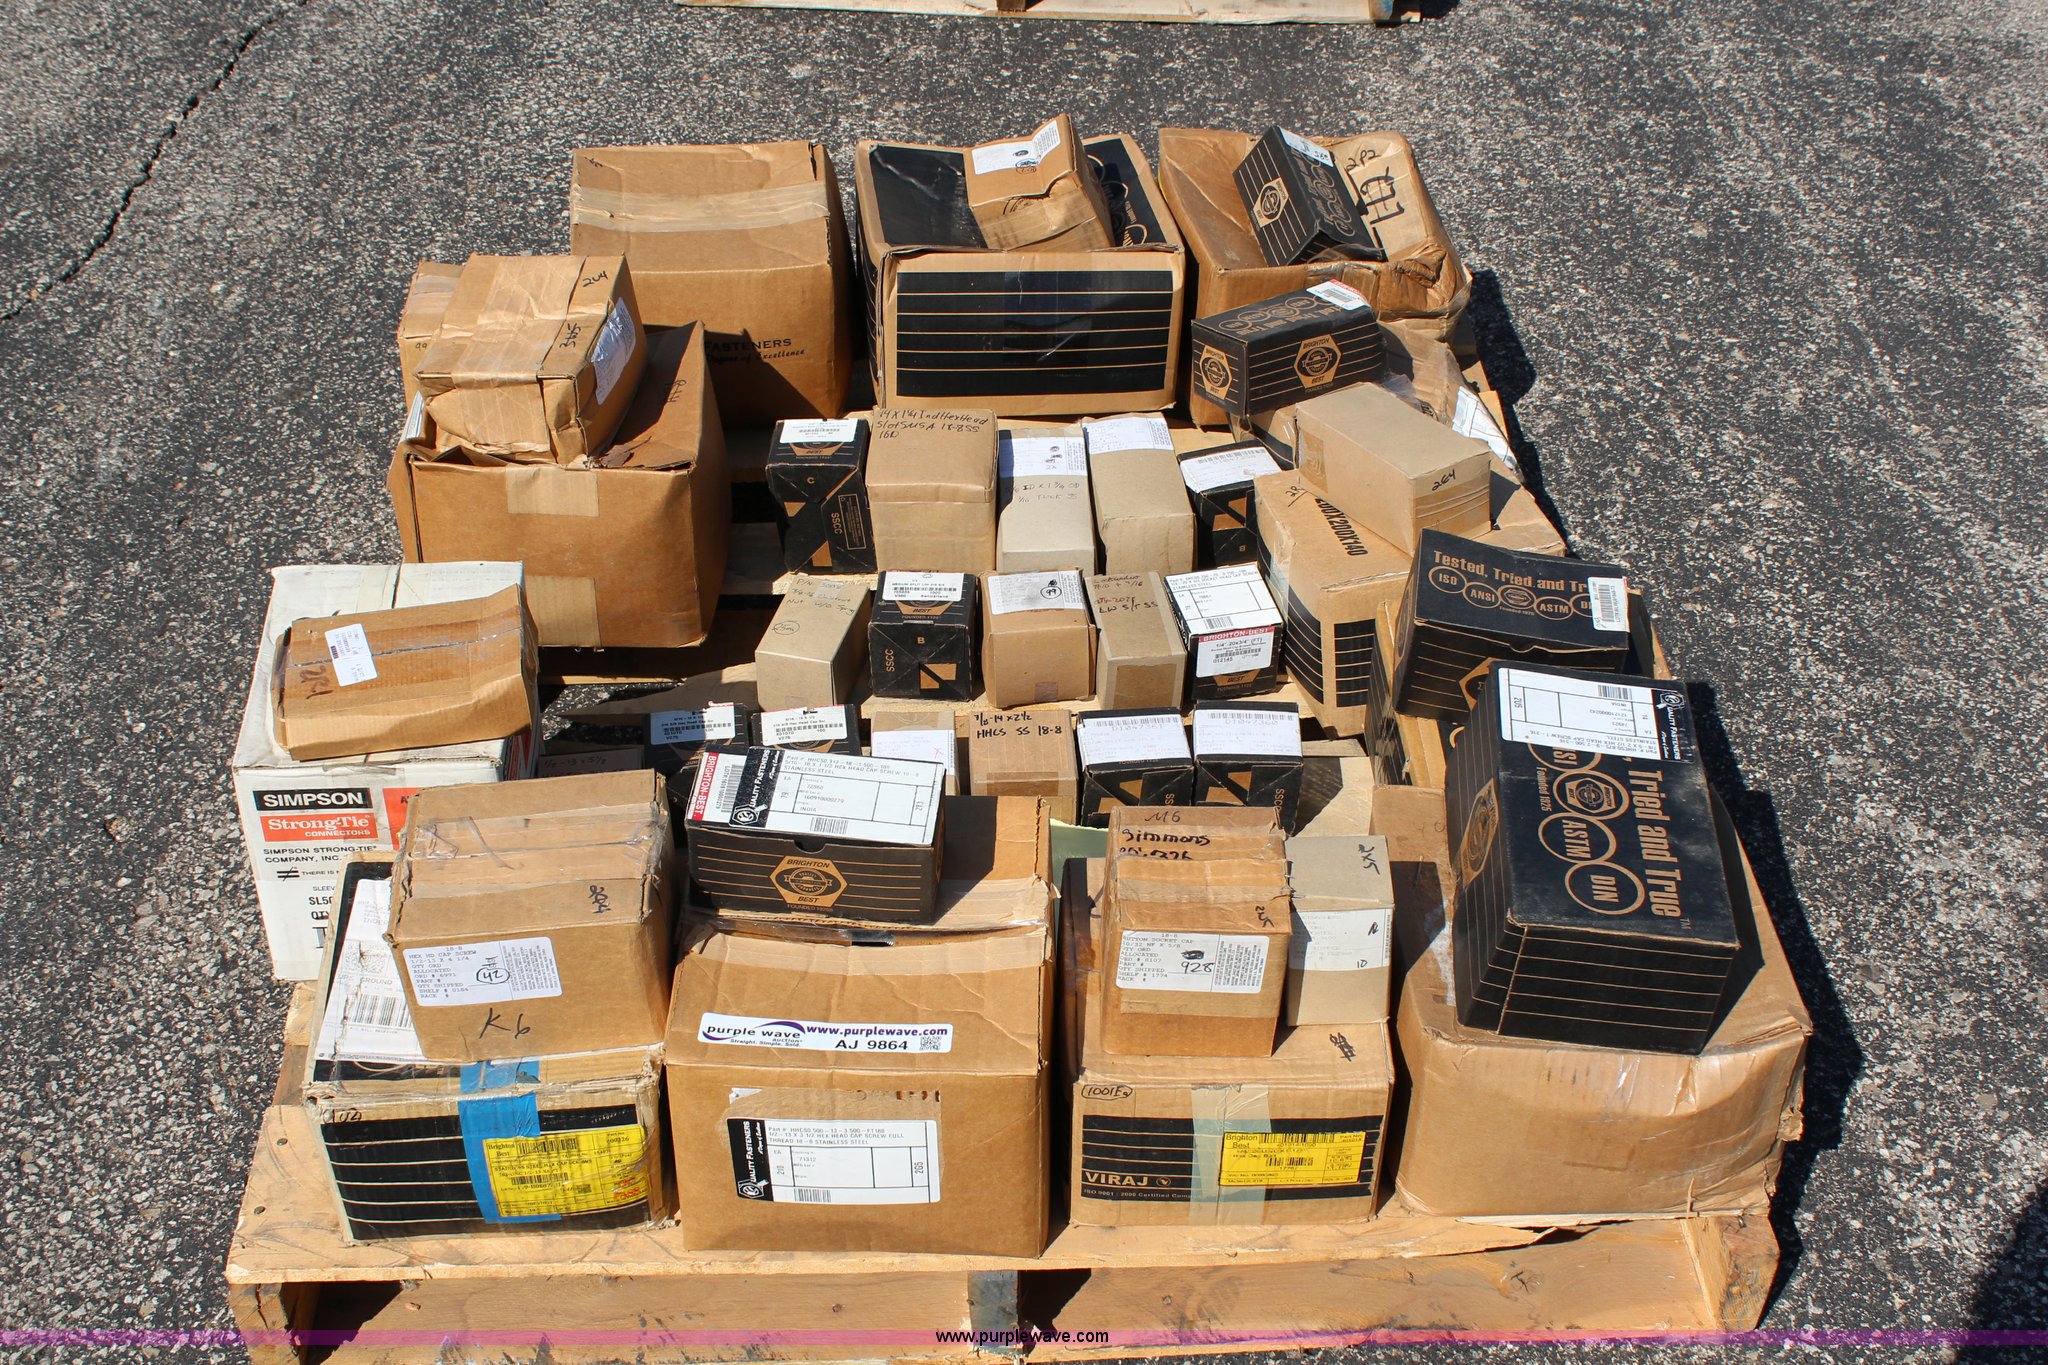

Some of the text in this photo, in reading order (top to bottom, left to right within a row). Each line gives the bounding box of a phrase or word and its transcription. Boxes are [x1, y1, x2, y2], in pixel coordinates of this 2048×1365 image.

[831, 512, 843, 535] SSCC
[1438, 573, 1458, 585] ISO
[1493, 567, 1533, 587] Tried
[1537, 578, 1565, 592] and
[1569, 580, 1589, 593] Tr
[1470, 589, 1495, 603] ANSI
[1539, 603, 1569, 614] ASTM
[917, 636, 925, 644] B
[1203, 627, 1269, 642] BRIGHTON-BEST
[884, 649, 895, 673] SSCC
[694, 755, 717, 815] BRIGHTON-BEST
[263, 792, 364, 807] SIMPSON
[1164, 793, 1175, 806] SS
[1628, 770, 1671, 821] Tried
[305, 829, 371, 837] CONNECTORS
[1122, 828, 1211, 846] Simmons
[1562, 819, 1591, 859] ASTM
[1637, 825, 1678, 863] and
[786, 859, 830, 868] BRIGHTON
[1590, 874, 1620, 903] DIN
[1645, 869, 1683, 918] True
[1181, 961, 1215, 974] 928
[706, 1025, 801, 1039] purple wave
[806, 1024, 949, 1038] www.purplewave.com
[835, 1039, 909, 1050] AJ 9864
[743, 1120, 754, 1160] FASTENERS
[1226, 1134, 1258, 1142] Brighton
[487, 1142, 516, 1151] Brighton
[1085, 1172, 1148, 1186] VIRAJ
